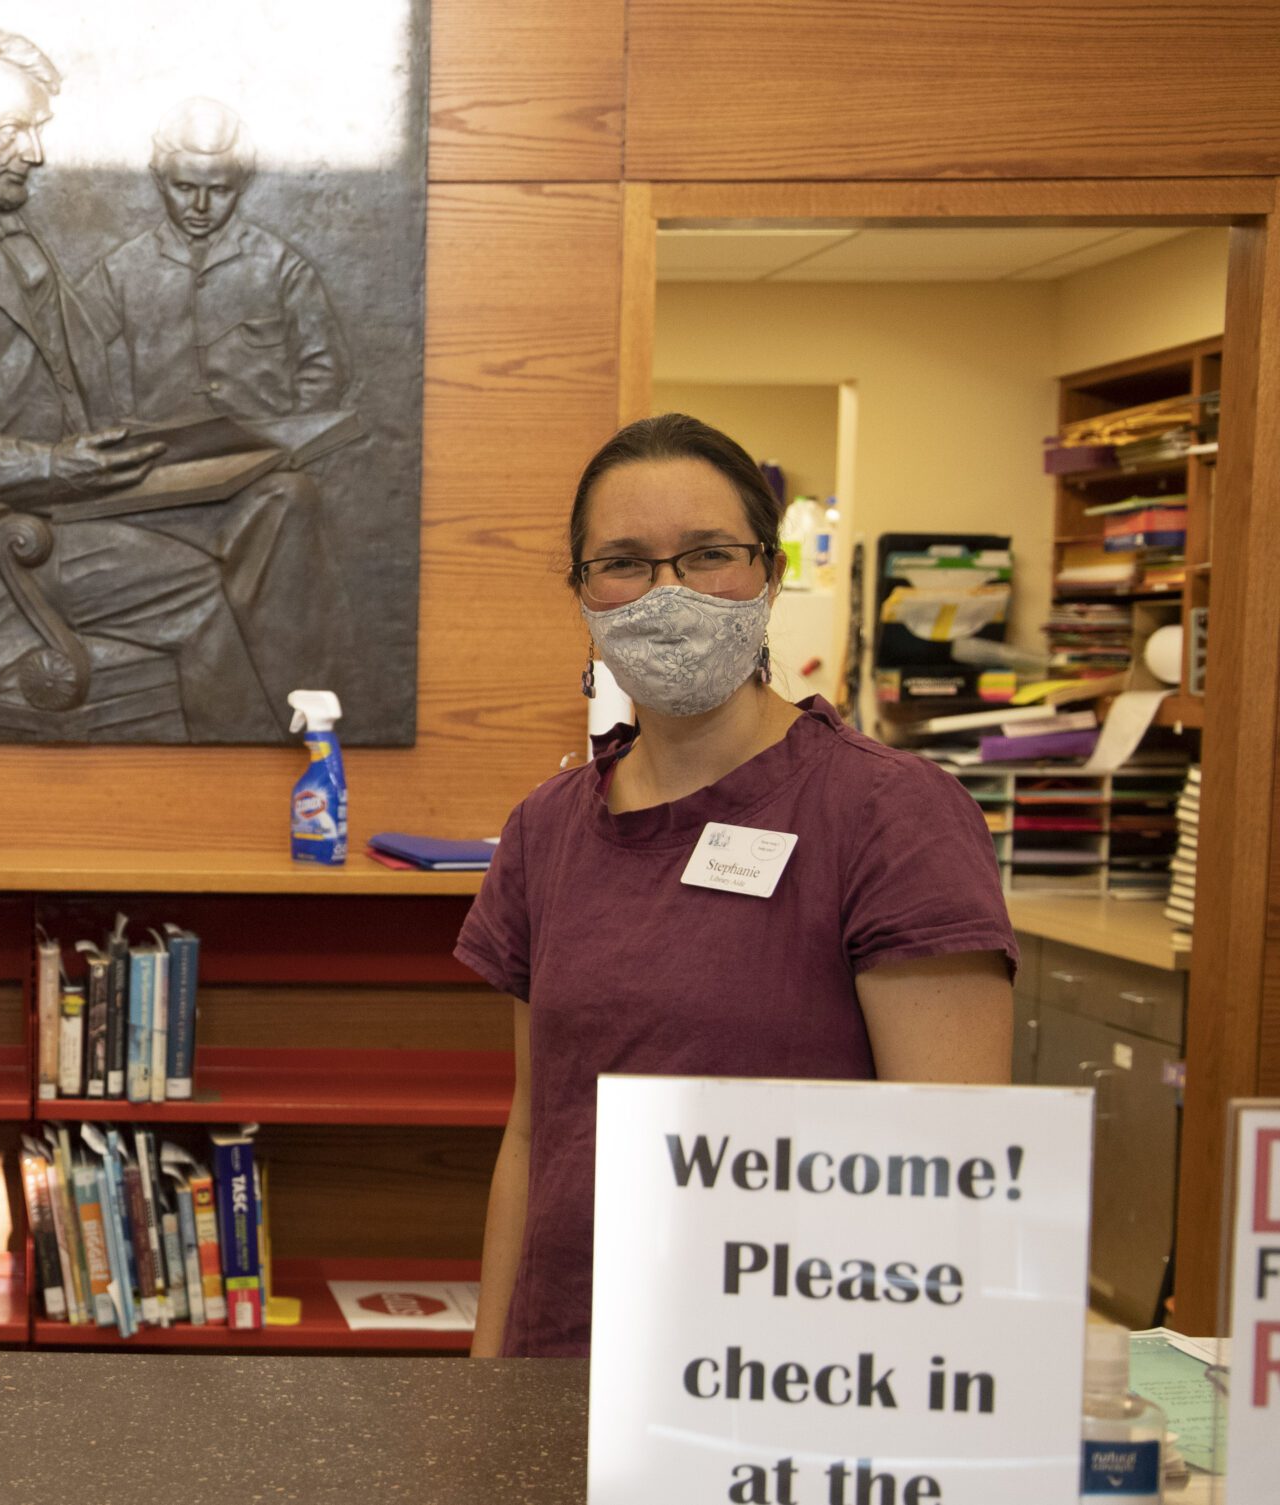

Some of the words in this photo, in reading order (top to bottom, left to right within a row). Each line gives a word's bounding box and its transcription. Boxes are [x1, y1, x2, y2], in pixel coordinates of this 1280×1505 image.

[707, 859, 761, 878] Stephanie
[231, 1173, 248, 1213] TASC
[665, 1133, 1025, 1201] Welcome!
[723, 1241, 964, 1305] Please
[683, 1346, 897, 1409] check
[929, 1355, 995, 1414] in
[728, 1457, 798, 1505] at
[825, 1457, 942, 1505] the
